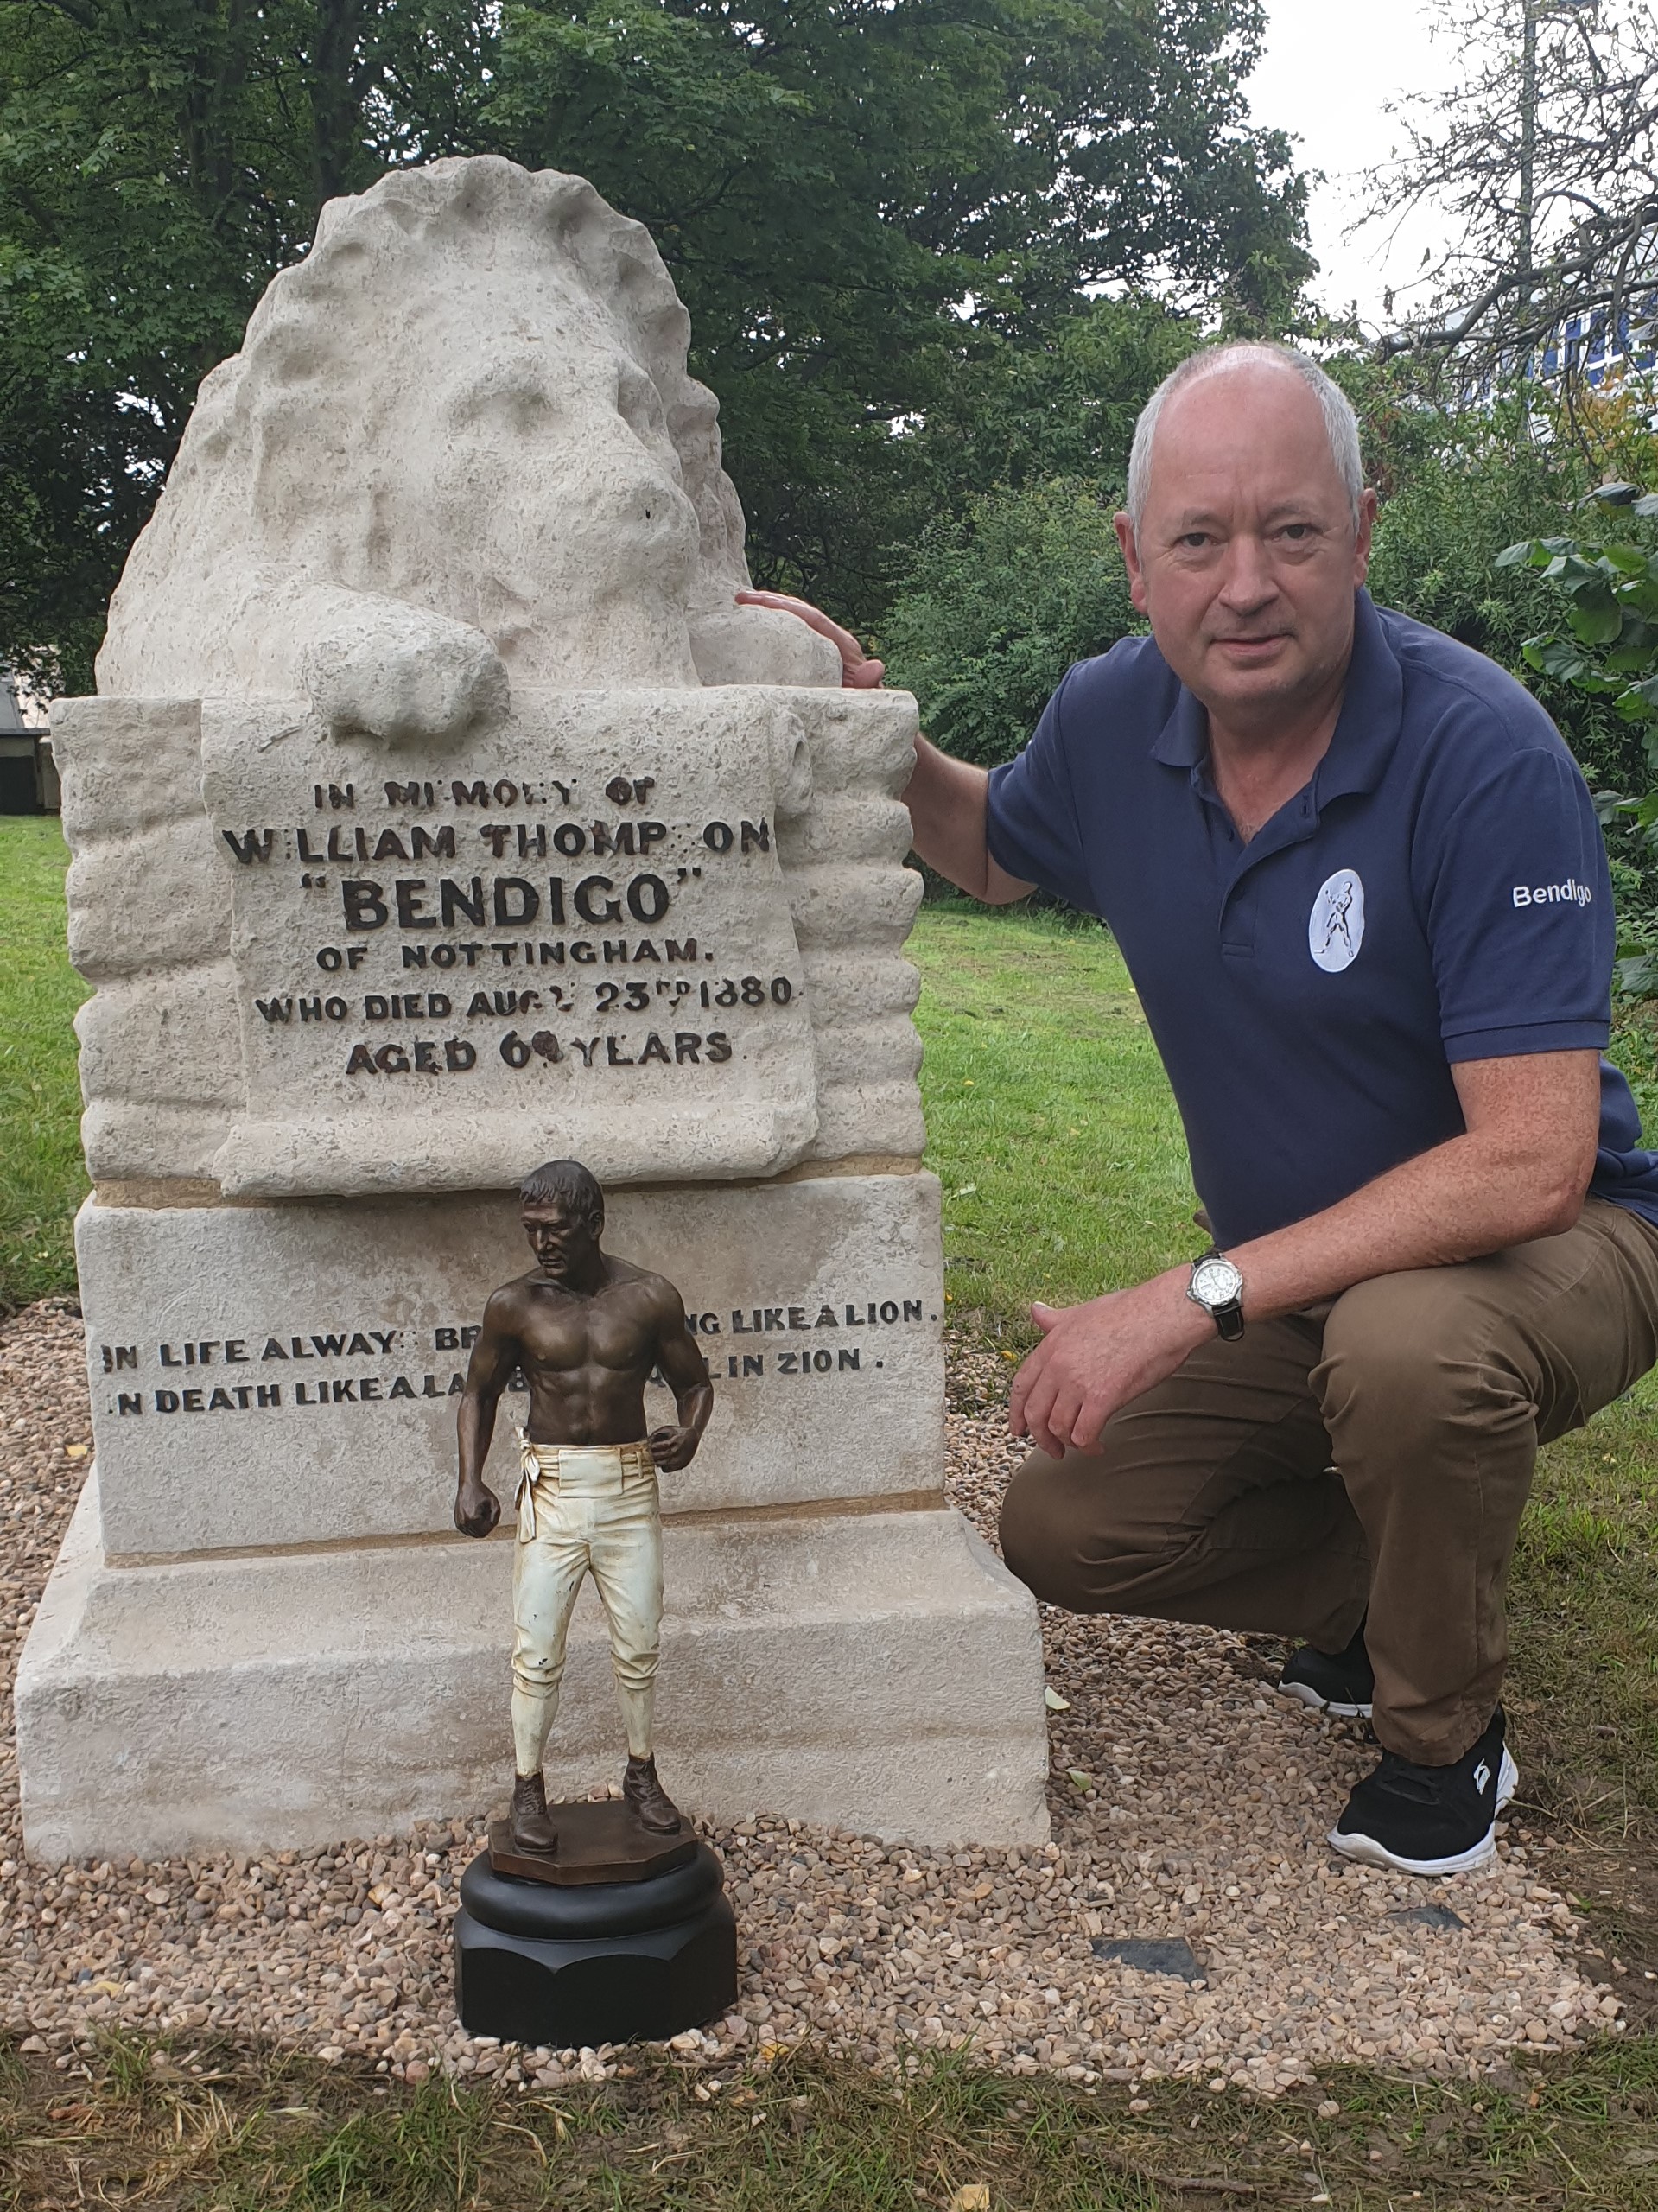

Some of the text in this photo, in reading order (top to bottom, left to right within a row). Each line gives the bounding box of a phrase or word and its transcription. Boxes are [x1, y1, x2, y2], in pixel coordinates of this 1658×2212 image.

[314, 784, 354, 807] IN
[221, 818, 769, 864] WLLIAM THOMPON
[1513, 878, 1591, 907] Bendigo
[316, 938, 714, 971] OF NOTTINGHAM.
[255, 995, 347, 1023] WHO
[365, 993, 452, 1020] DIED
[346, 1039, 476, 1076] AGED
[101, 1344, 137, 1374] IN
[160, 1339, 250, 1367] LIFE
[262, 1328, 420, 1363] ALWAY
[731, 1307, 812, 1334] LIKE
[814, 1304, 839, 1328] A
[845, 1300, 937, 1328] LION.
[106, 1392, 143, 1416] N
[156, 1382, 289, 1414] DEATH
[295, 1377, 384, 1405] LIKE
[388, 1376, 415, 1401] A
[728, 1353, 763, 1379] IN
